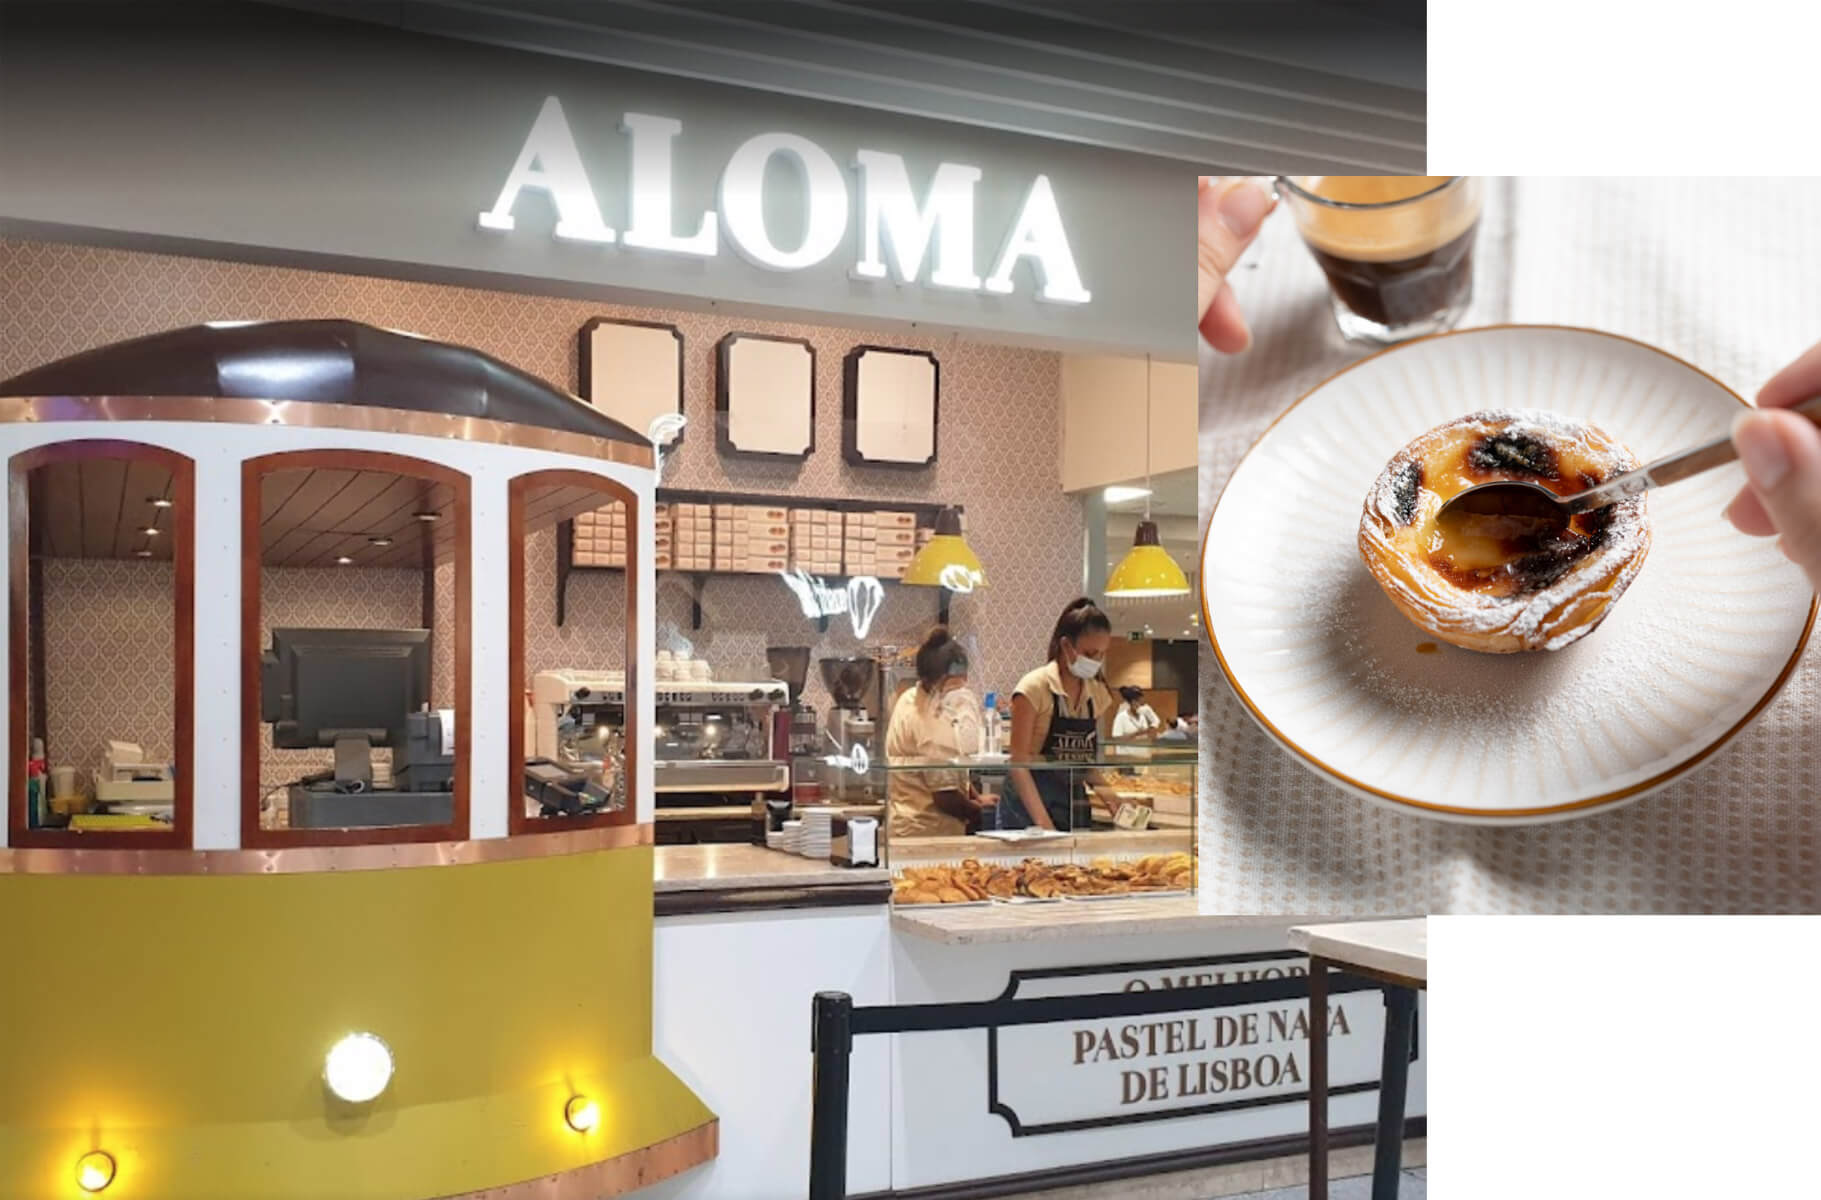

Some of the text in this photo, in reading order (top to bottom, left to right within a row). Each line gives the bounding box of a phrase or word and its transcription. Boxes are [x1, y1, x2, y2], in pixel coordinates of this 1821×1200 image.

[478, 95, 1092, 303] ALOMA
[1073, 1004, 1351, 1065] PASTEL DE NAA
[1120, 1051, 1303, 1106] DE LISBOA
